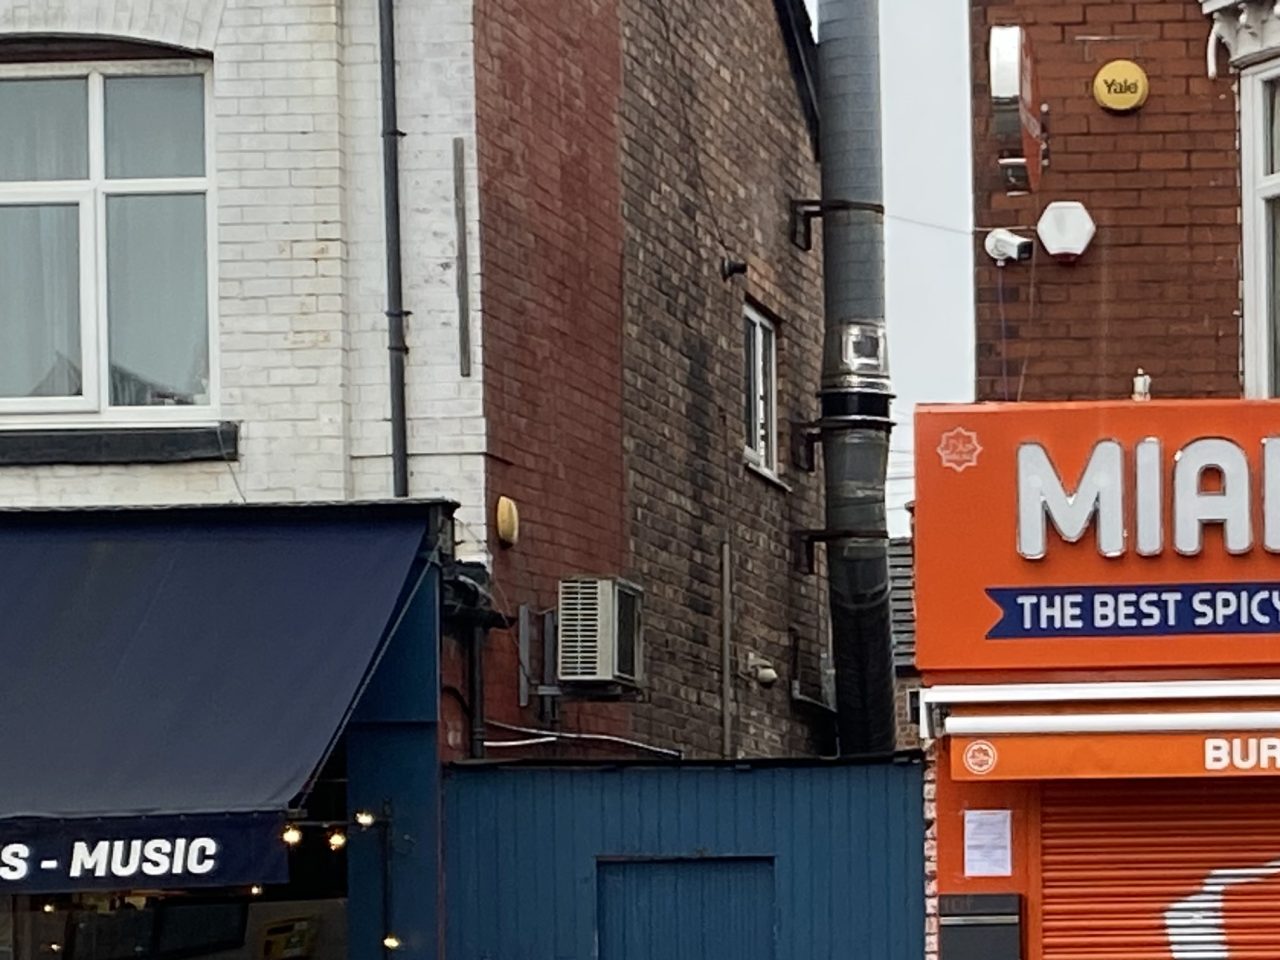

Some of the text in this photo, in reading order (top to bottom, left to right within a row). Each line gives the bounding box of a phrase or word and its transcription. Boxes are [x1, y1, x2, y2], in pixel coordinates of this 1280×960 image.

[1102, 78, 1139, 95] Yale
[1016, 594, 1083, 629] THE
[1093, 591, 1182, 628] BEST
[69, 837, 217, 877] MUSIC
